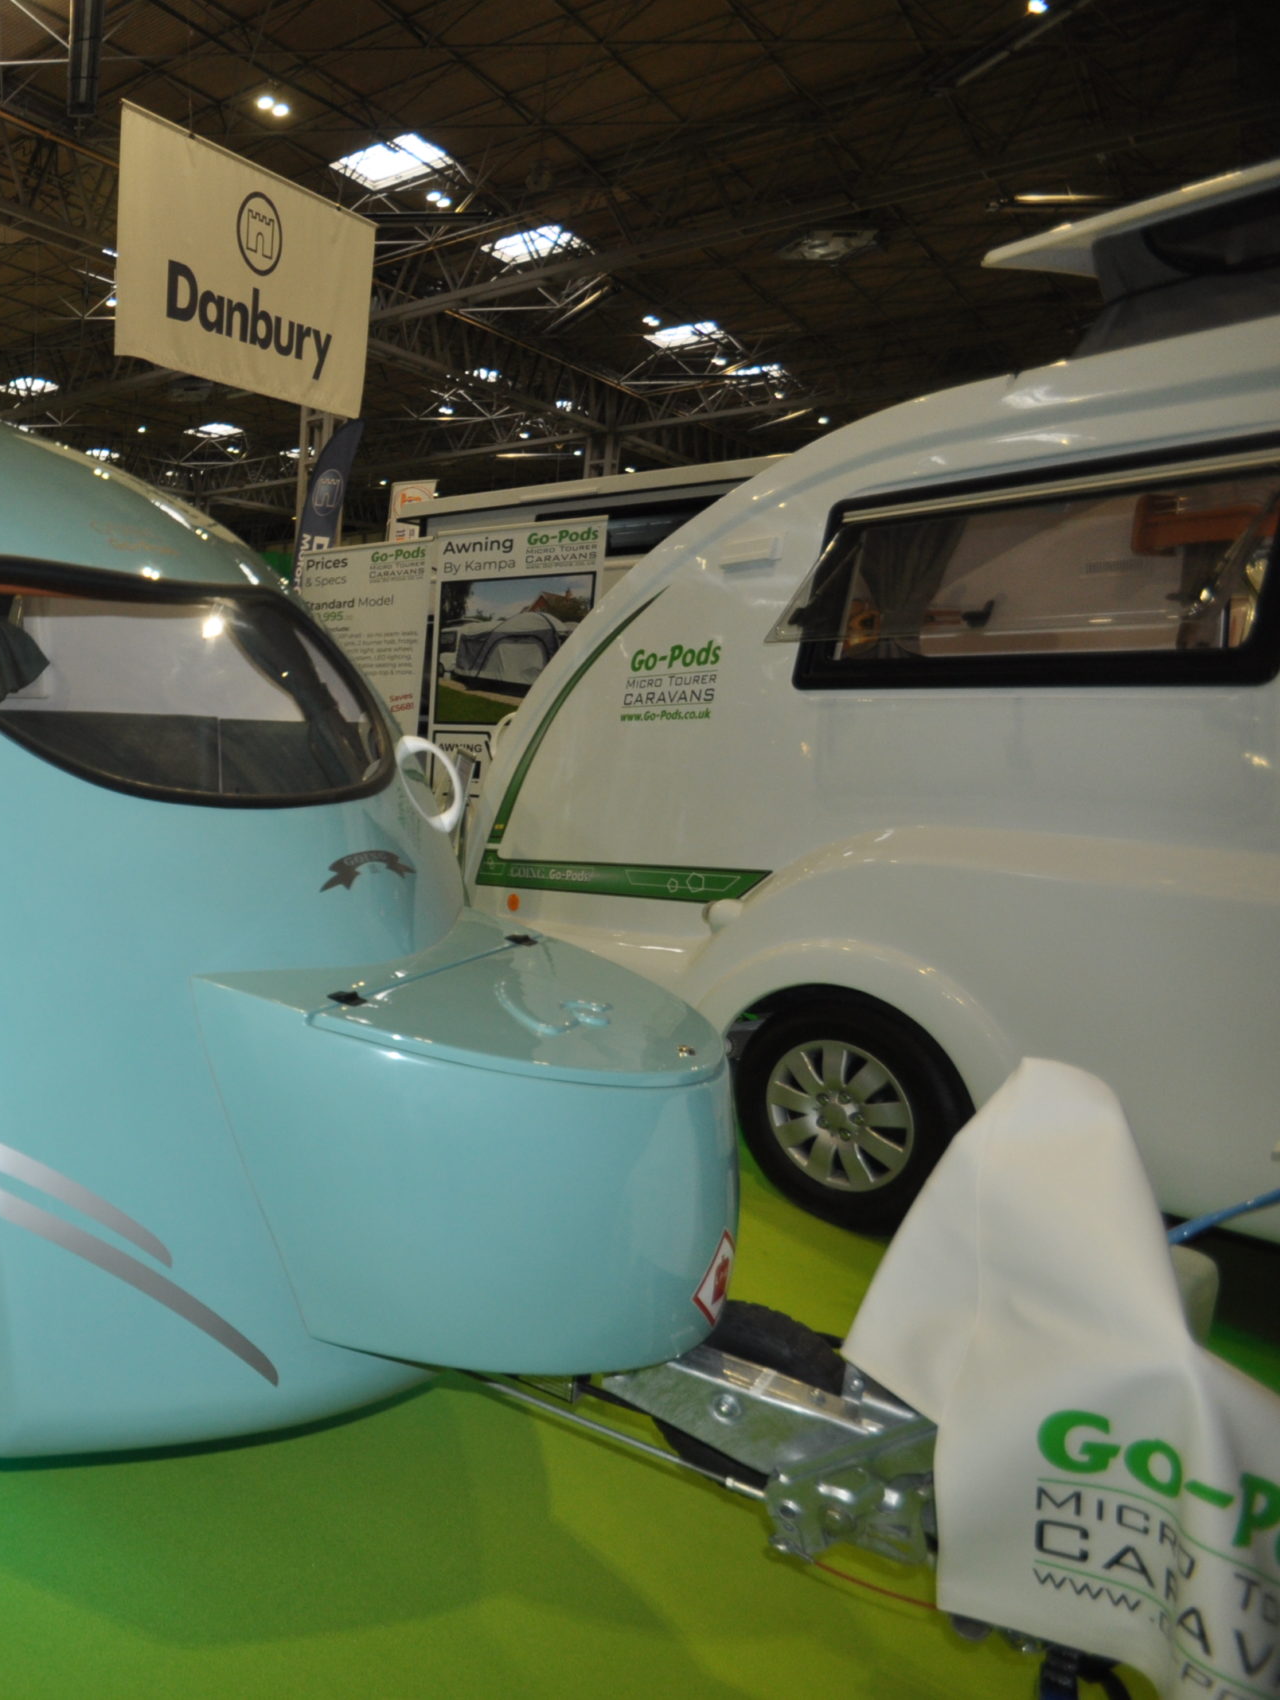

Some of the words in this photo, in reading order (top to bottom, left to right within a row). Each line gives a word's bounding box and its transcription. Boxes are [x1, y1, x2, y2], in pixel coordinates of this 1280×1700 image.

[166, 259, 333, 381] Danbury
[527, 527, 599, 546] Go-Pods
[443, 537, 514, 555] Awning
[370, 546, 426, 563] Go-Pods
[525, 552, 597, 564] CARAVANS
[306, 557, 348, 571] Prices
[443, 561, 461, 575] By
[465, 559, 516, 572] Kampa
[315, 576, 347, 589] Specs
[358, 595, 394, 608] Model
[631, 640, 722, 672] Go-Pods
[626, 678, 663, 690] MICRO
[669, 674, 717, 687] TOURER
[623, 688, 715, 706] CARAVANS
[620, 707, 712, 722] www.Go-Pods.co.uk
